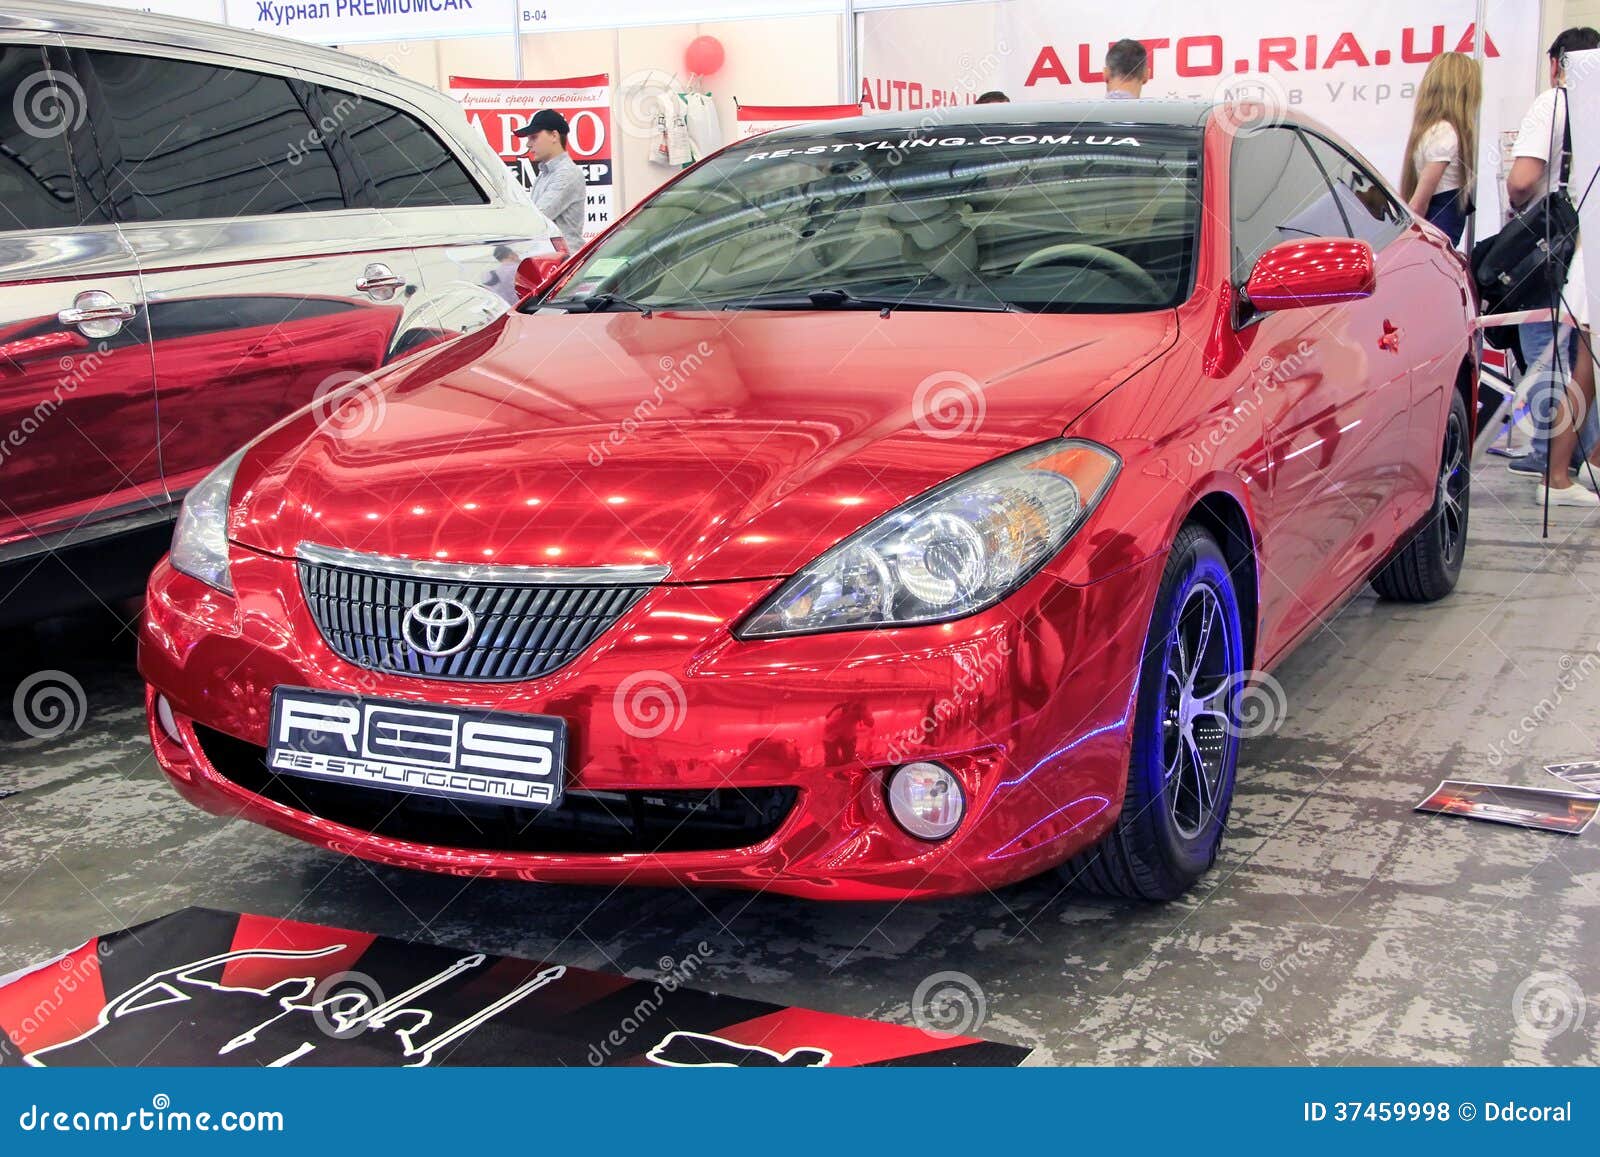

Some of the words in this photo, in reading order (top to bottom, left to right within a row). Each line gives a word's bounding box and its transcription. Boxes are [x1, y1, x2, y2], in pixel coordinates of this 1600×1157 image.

[257, 1, 330, 26] Журнал
[523, 10, 547, 22] B-04
[1024, 23, 1501, 87] AUTO.RIA.UA
[1326, 81, 1416, 106] Укра
[744, 133, 1142, 163] RE-STYLING.COM.UA
